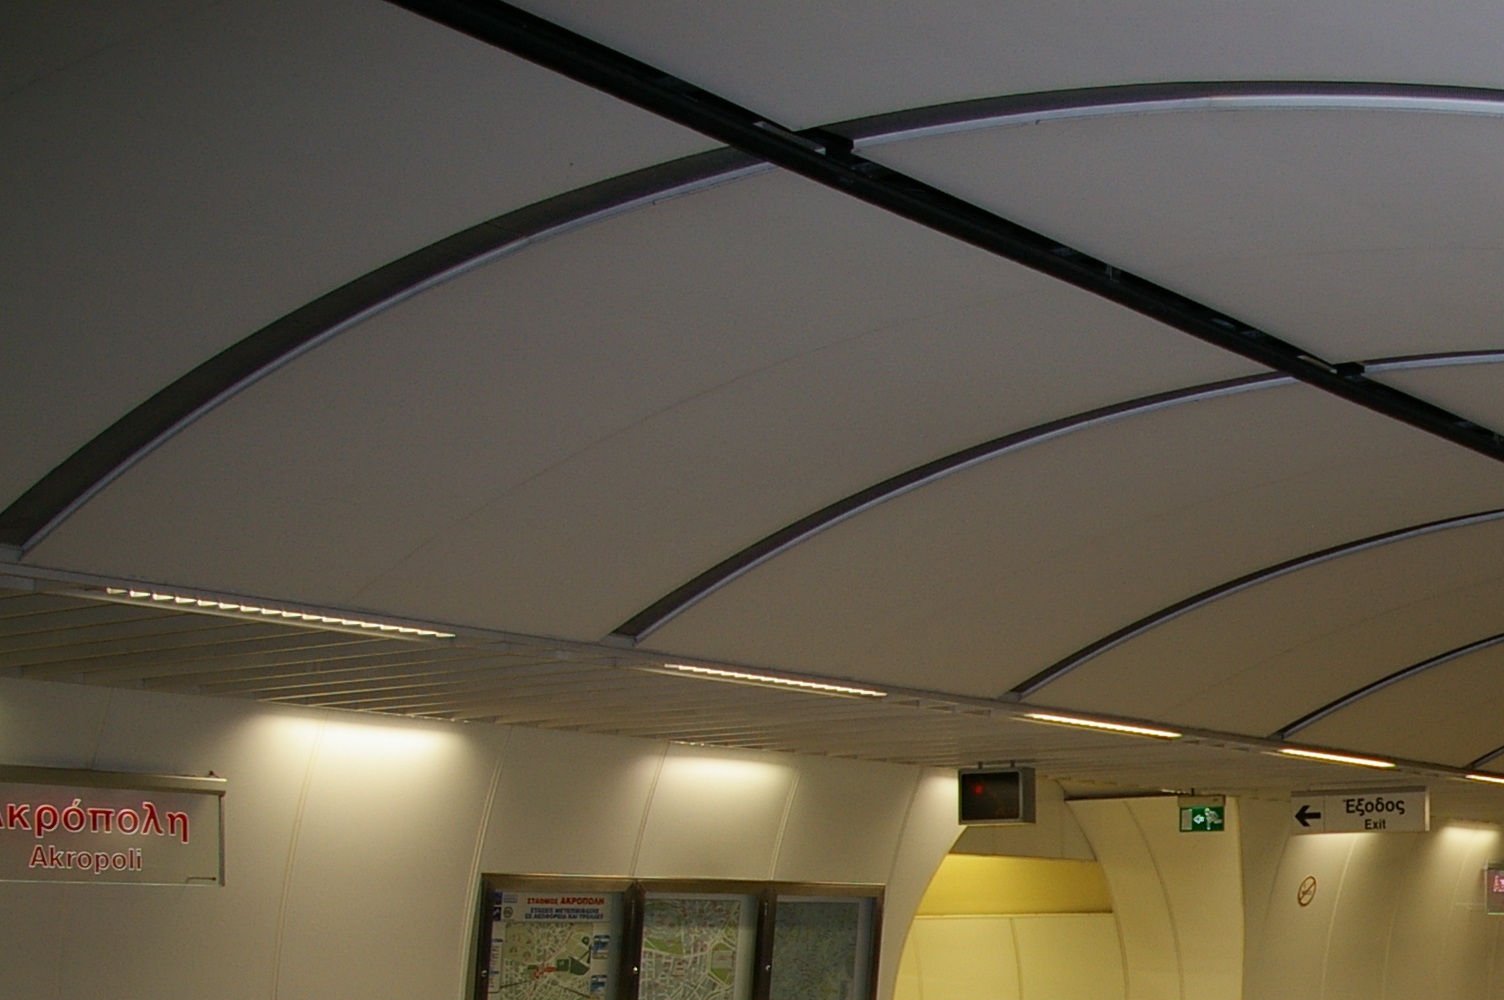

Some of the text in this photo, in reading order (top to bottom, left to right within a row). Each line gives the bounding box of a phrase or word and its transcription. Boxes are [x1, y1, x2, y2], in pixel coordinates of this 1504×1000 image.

[1342, 796, 1406, 817] Έξοδος
[0, 797, 190, 845] κρόπολη
[1364, 818, 1387, 830] Exit
[28, 844, 143, 875] Akropoli
